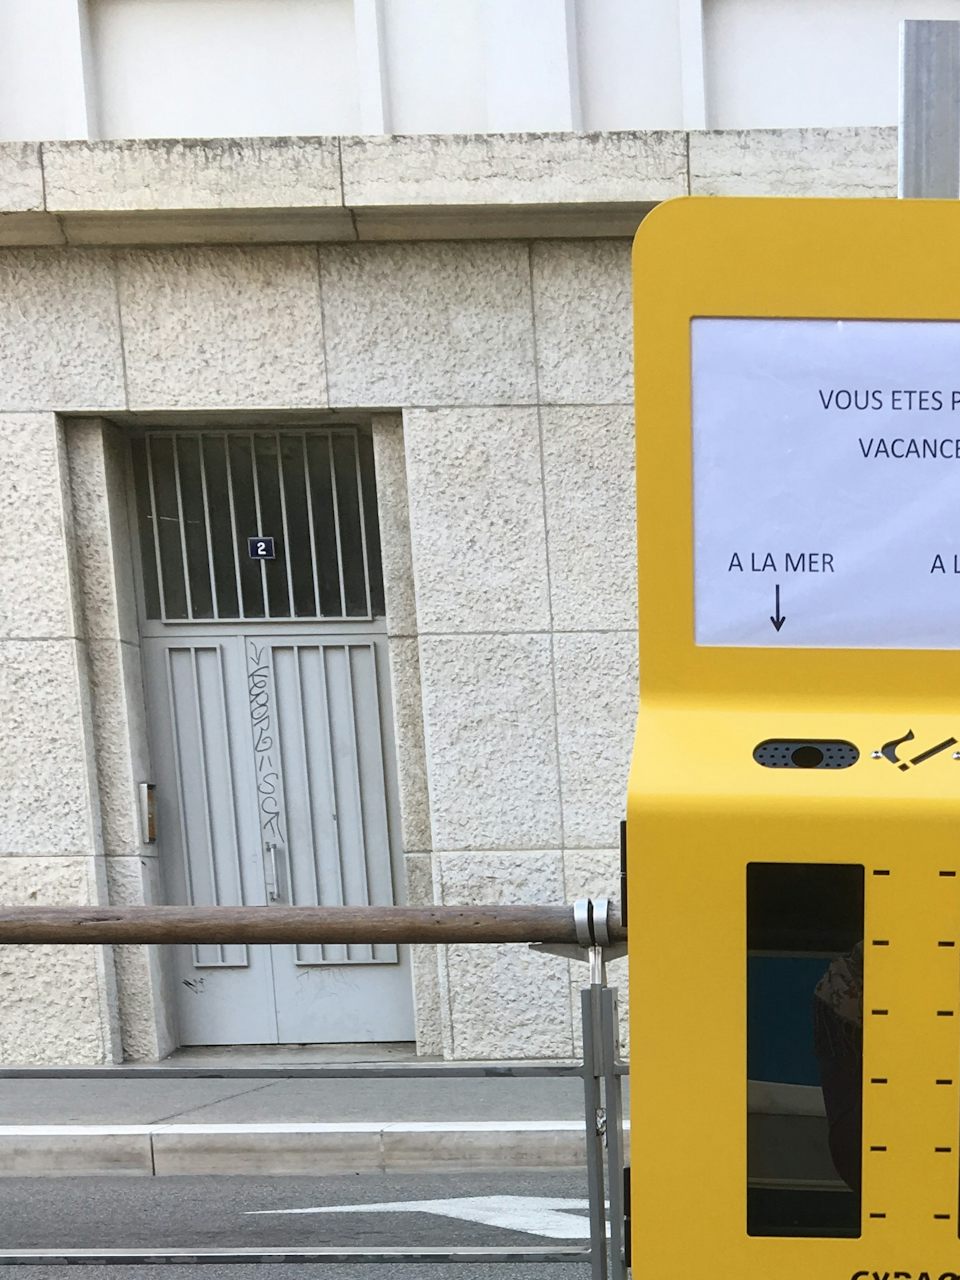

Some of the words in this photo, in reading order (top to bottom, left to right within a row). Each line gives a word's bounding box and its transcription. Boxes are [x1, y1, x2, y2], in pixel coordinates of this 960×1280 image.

[818, 389, 883, 411] VOUS
[891, 390, 943, 411] ETES
[257, 541, 267, 555] 2
[728, 552, 744, 572] A
[751, 552, 777, 573] LA
[785, 552, 835, 573] MER
[930, 553, 946, 574] A
